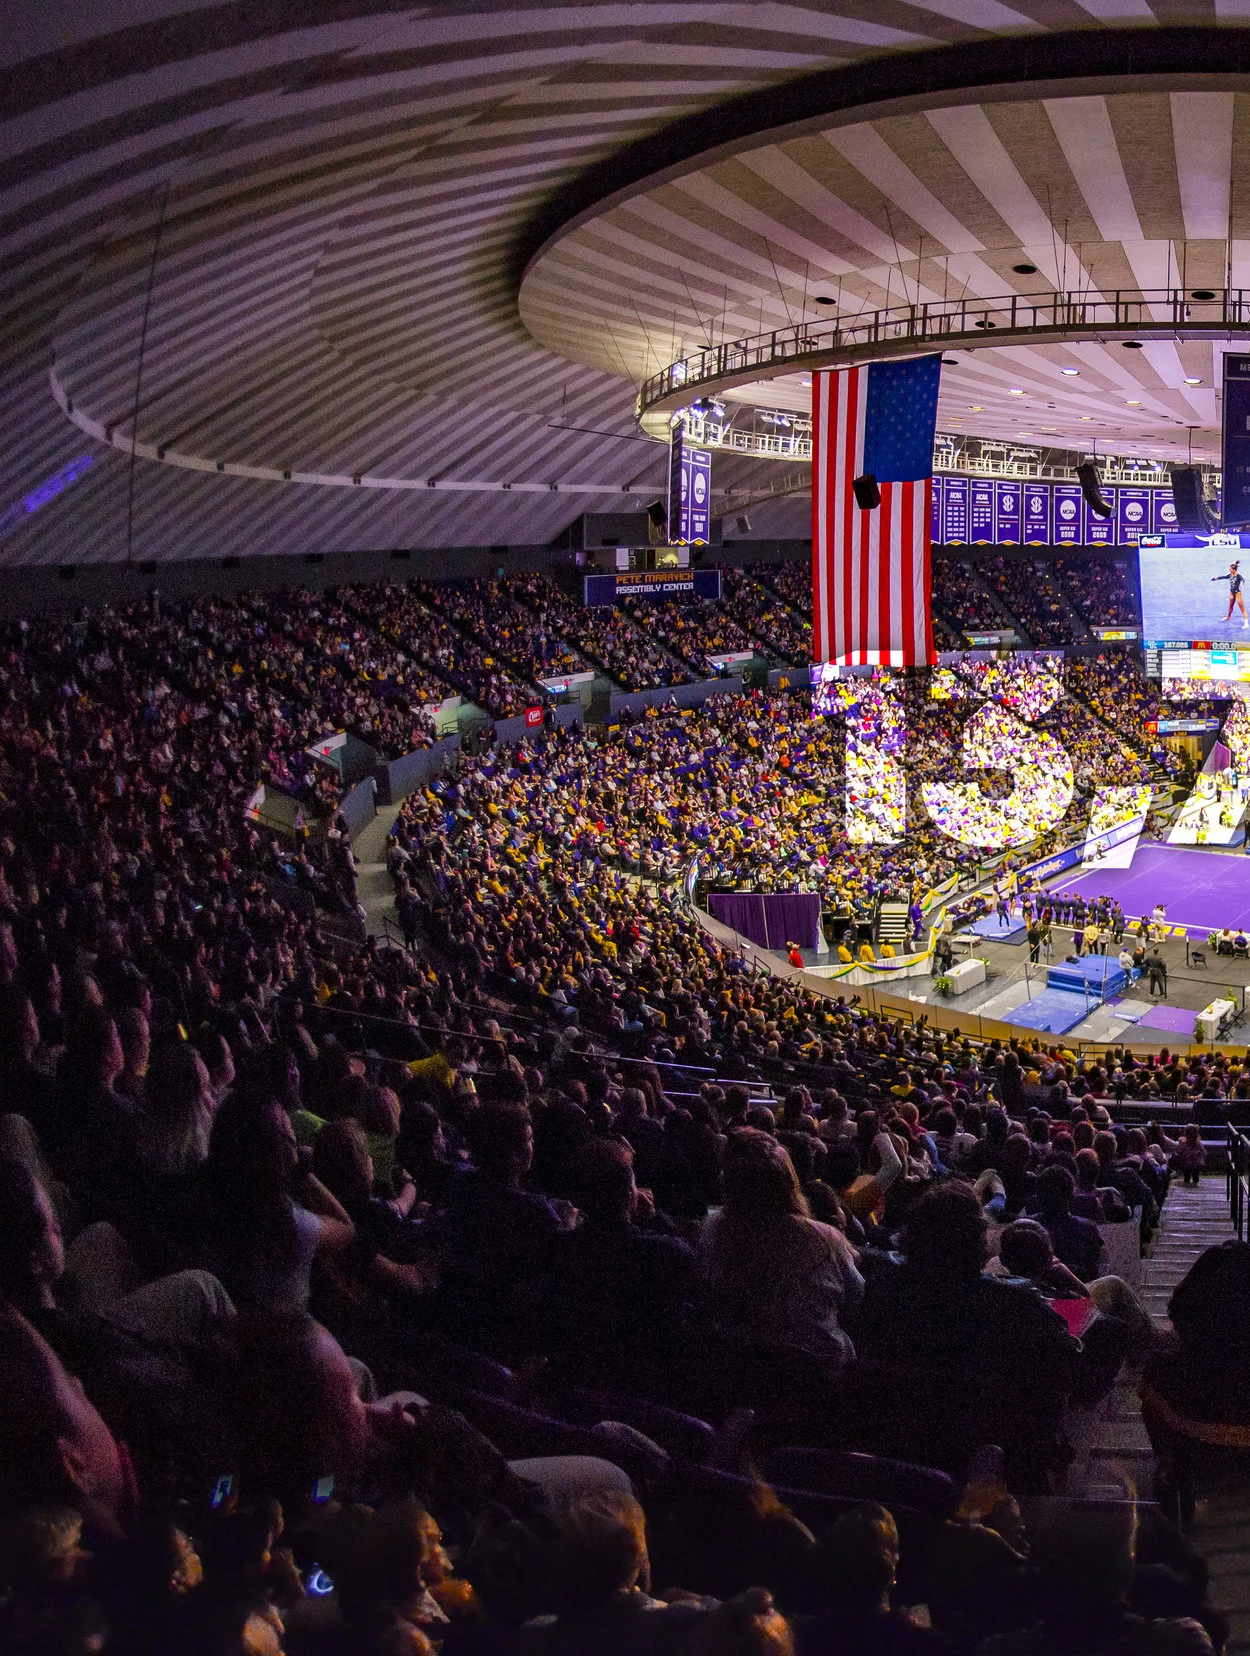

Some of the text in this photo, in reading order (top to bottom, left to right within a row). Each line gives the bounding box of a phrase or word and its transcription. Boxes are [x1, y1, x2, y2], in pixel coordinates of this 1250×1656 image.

[616, 572, 694, 584] PETE MARAVICH
[616, 582, 694, 594] ASSEMBLY CENTER
